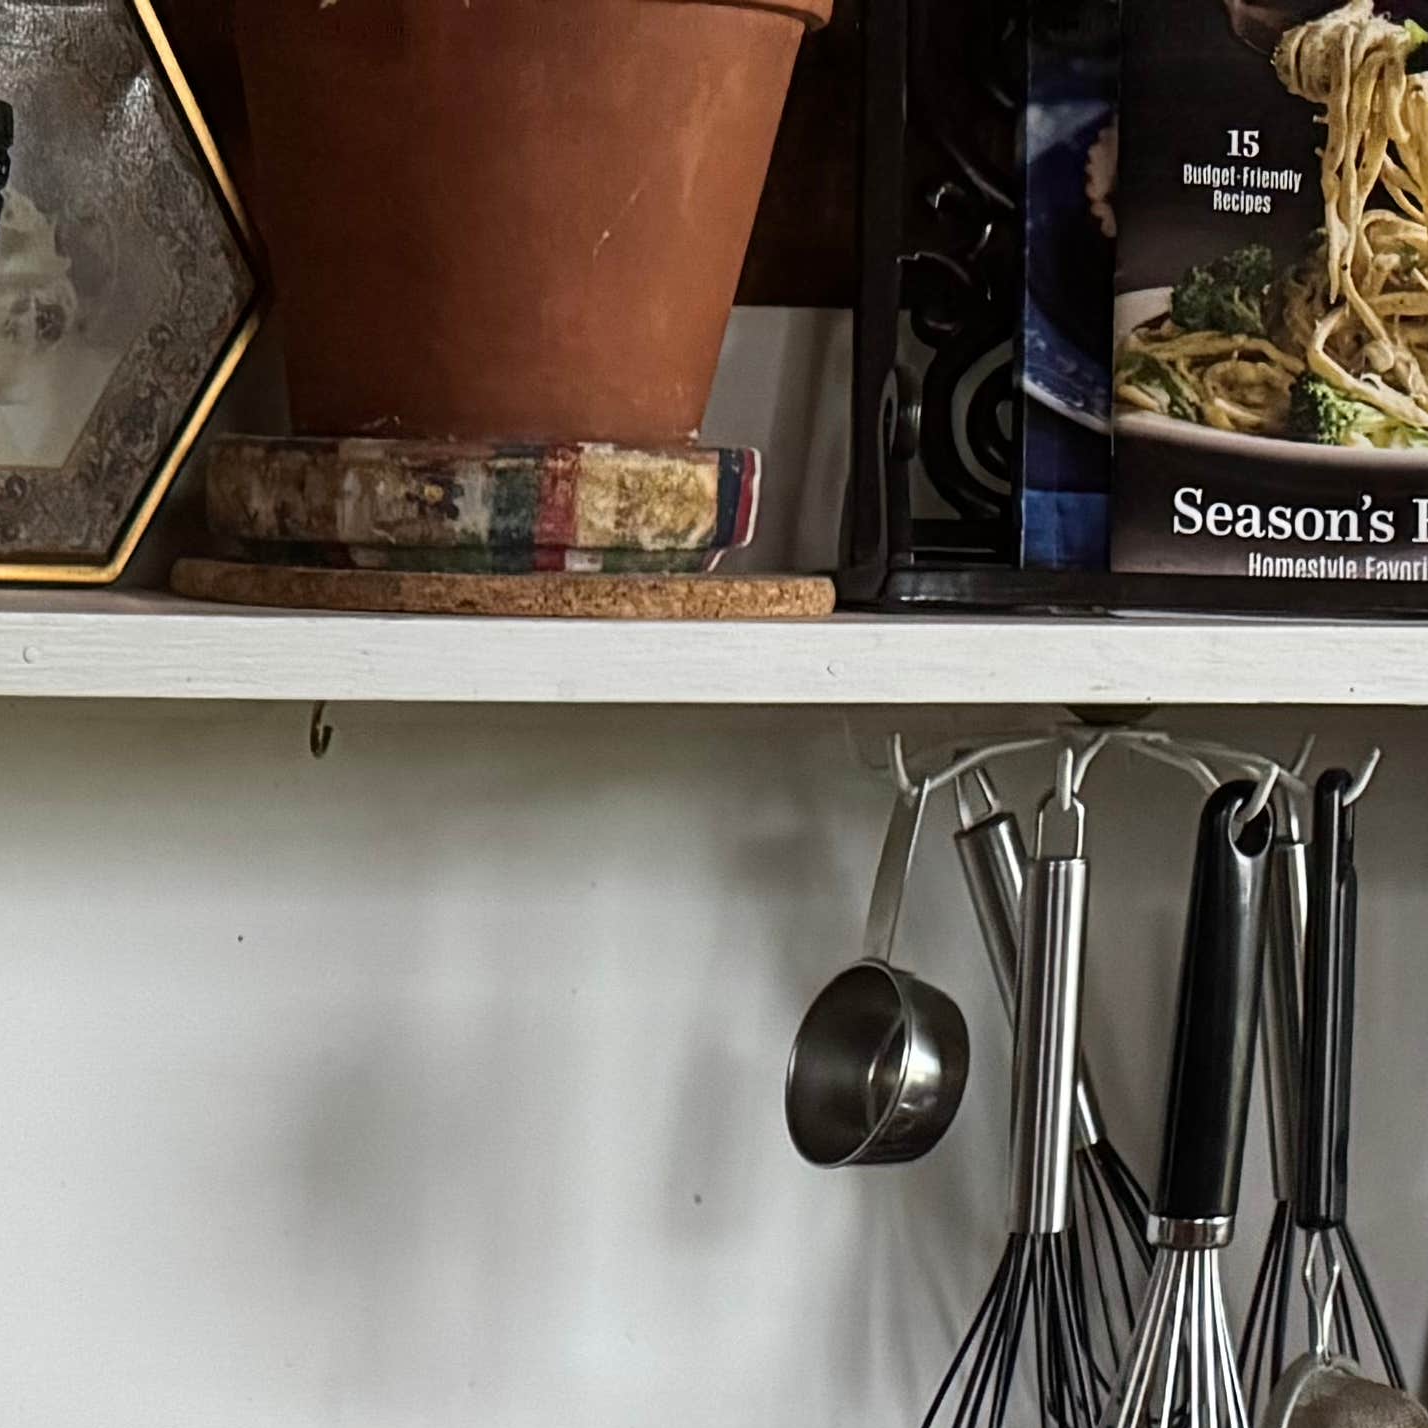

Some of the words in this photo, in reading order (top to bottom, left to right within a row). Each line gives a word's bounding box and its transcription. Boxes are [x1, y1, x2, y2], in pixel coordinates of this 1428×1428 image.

[1226, 129, 1260, 158] 15
[1183, 163, 1303, 193] Budget-Friendly
[1213, 190, 1272, 214] Recipes
[1172, 487, 1395, 544] Season's
